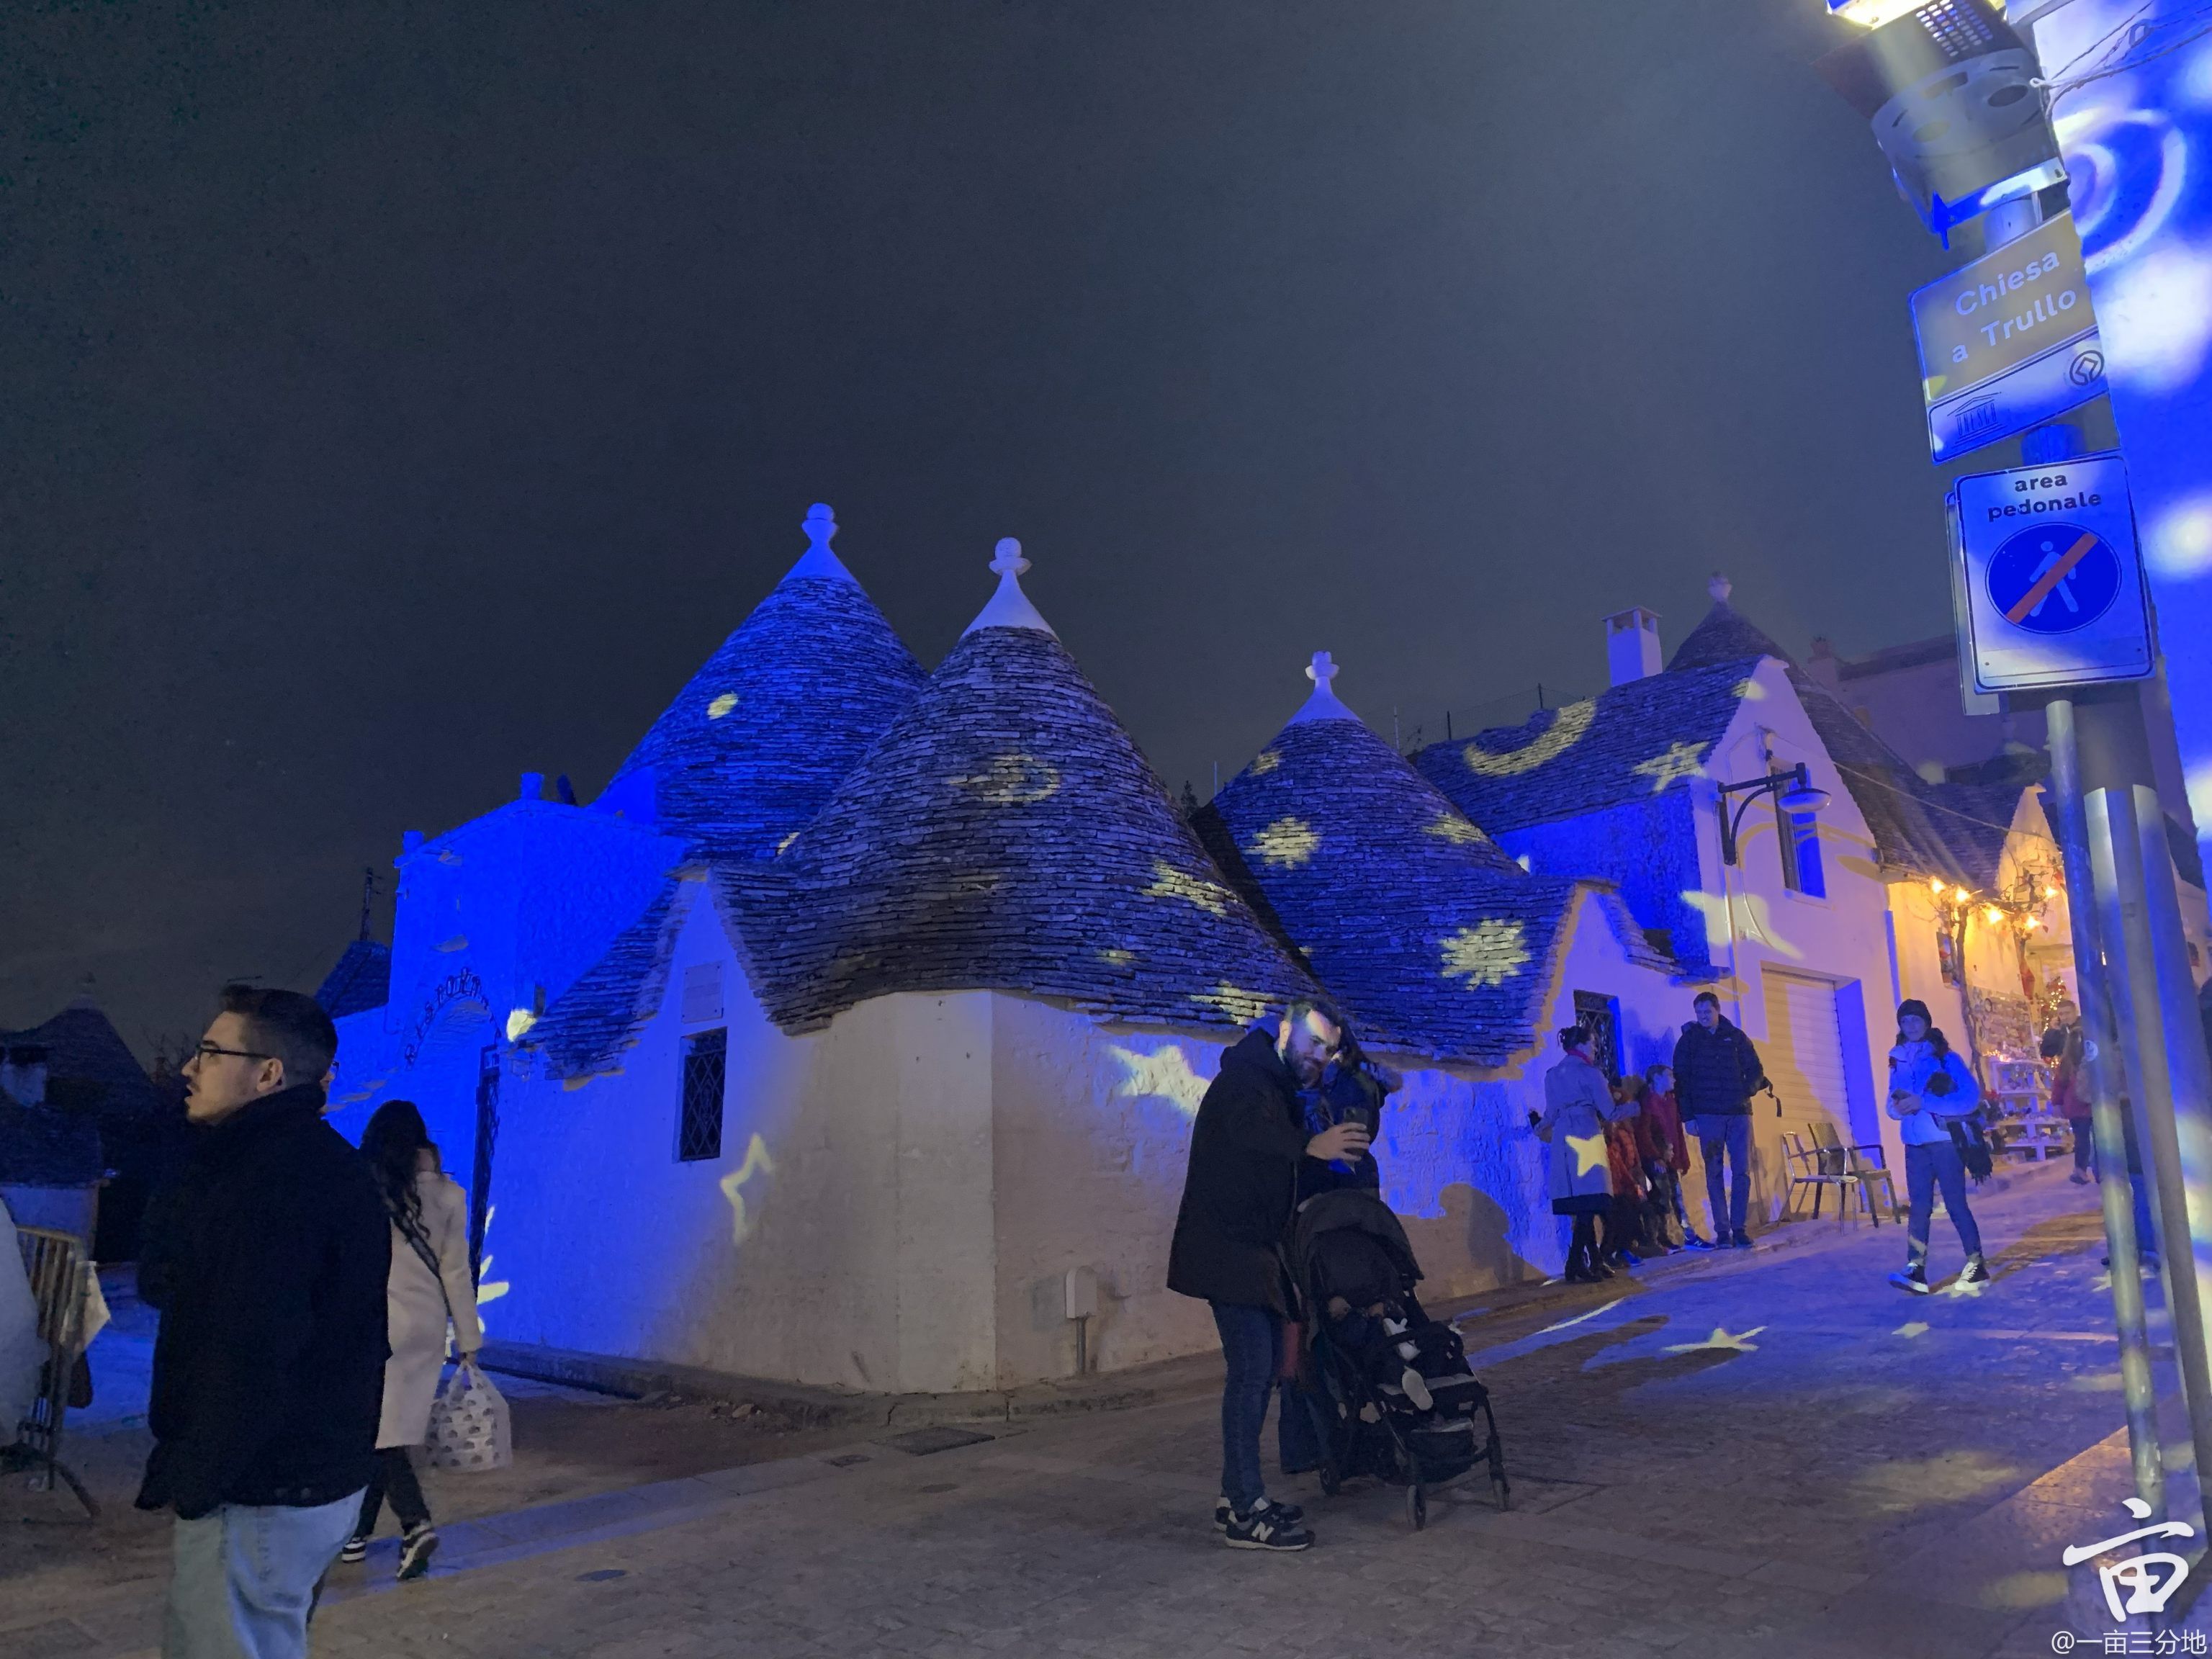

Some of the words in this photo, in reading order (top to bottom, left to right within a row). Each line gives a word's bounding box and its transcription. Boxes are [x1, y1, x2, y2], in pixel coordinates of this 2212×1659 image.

[1955, 251, 2060, 315] Chiesa
[1952, 343, 1969, 363] a
[1981, 289, 2077, 346] Trullo
[2015, 474, 2068, 492] area
[1987, 491, 2102, 523] pedonale
[1251, 1520, 1274, 1542] N
